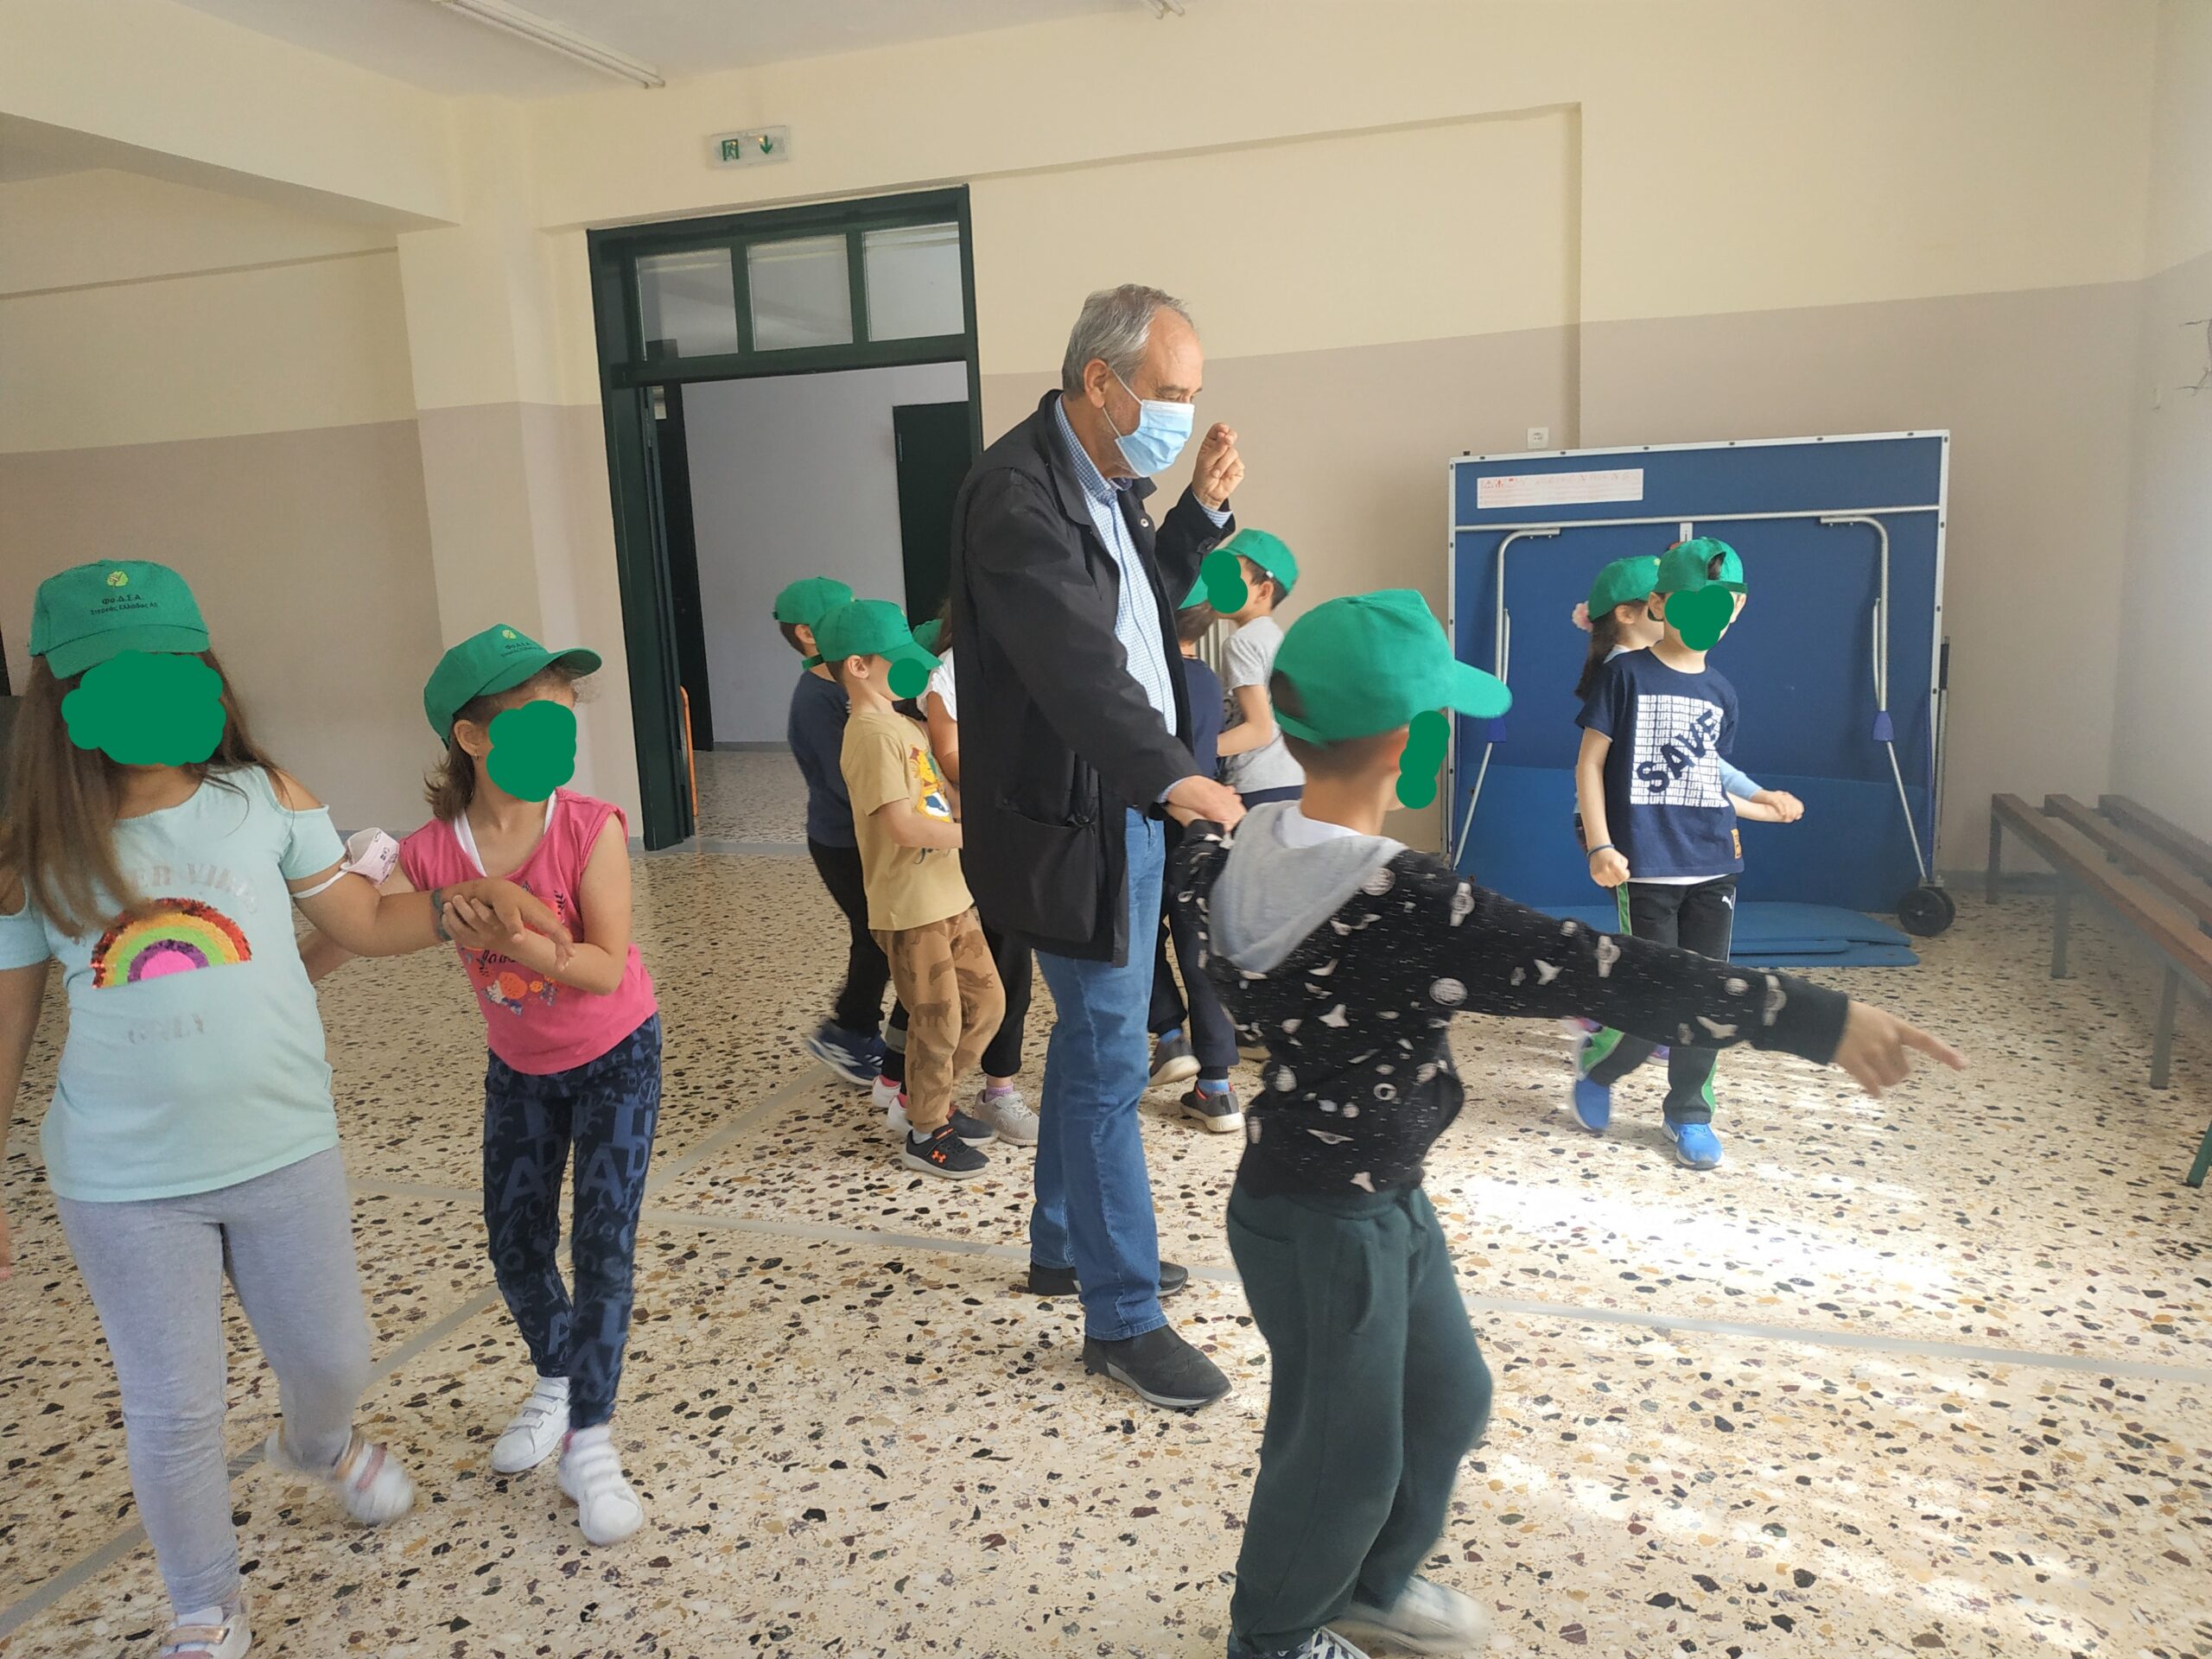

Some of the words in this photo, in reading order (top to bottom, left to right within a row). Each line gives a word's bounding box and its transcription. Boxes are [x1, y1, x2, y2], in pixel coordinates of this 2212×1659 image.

[1638, 695, 1656, 703] WILD
[1657, 695, 1672, 703] LIFE
[1672, 696, 1690, 706] WILD
[1690, 698, 1703, 708] LIFE
[1638, 703, 1656, 712] WILD
[1657, 703, 1672, 712] LIFE
[1672, 704, 1690, 714] WILD
[1690, 707, 1703, 716] LIFE
[1637, 712, 1656, 721] WILD
[1656, 712, 1671, 721] LIFE
[1672, 713, 1690, 722] WILD
[1637, 721, 1655, 729] WILD
[1656, 721, 1671, 729] LIFE
[1672, 721, 1690, 730] WILD
[1655, 729, 1670, 738] LIFE
[1637, 709, 1717, 793] SAVE
[1688, 772, 1701, 782] LIFE
[1688, 781, 1702, 790] LIFE
[1630, 787, 1649, 796] WILD
[1666, 788, 1685, 797] WILD
[1686, 789, 1702, 798] LIFE
[1630, 796, 1649, 804] WILD
[1649, 796, 1665, 804] LIFE
[1665, 796, 1684, 805] WILD
